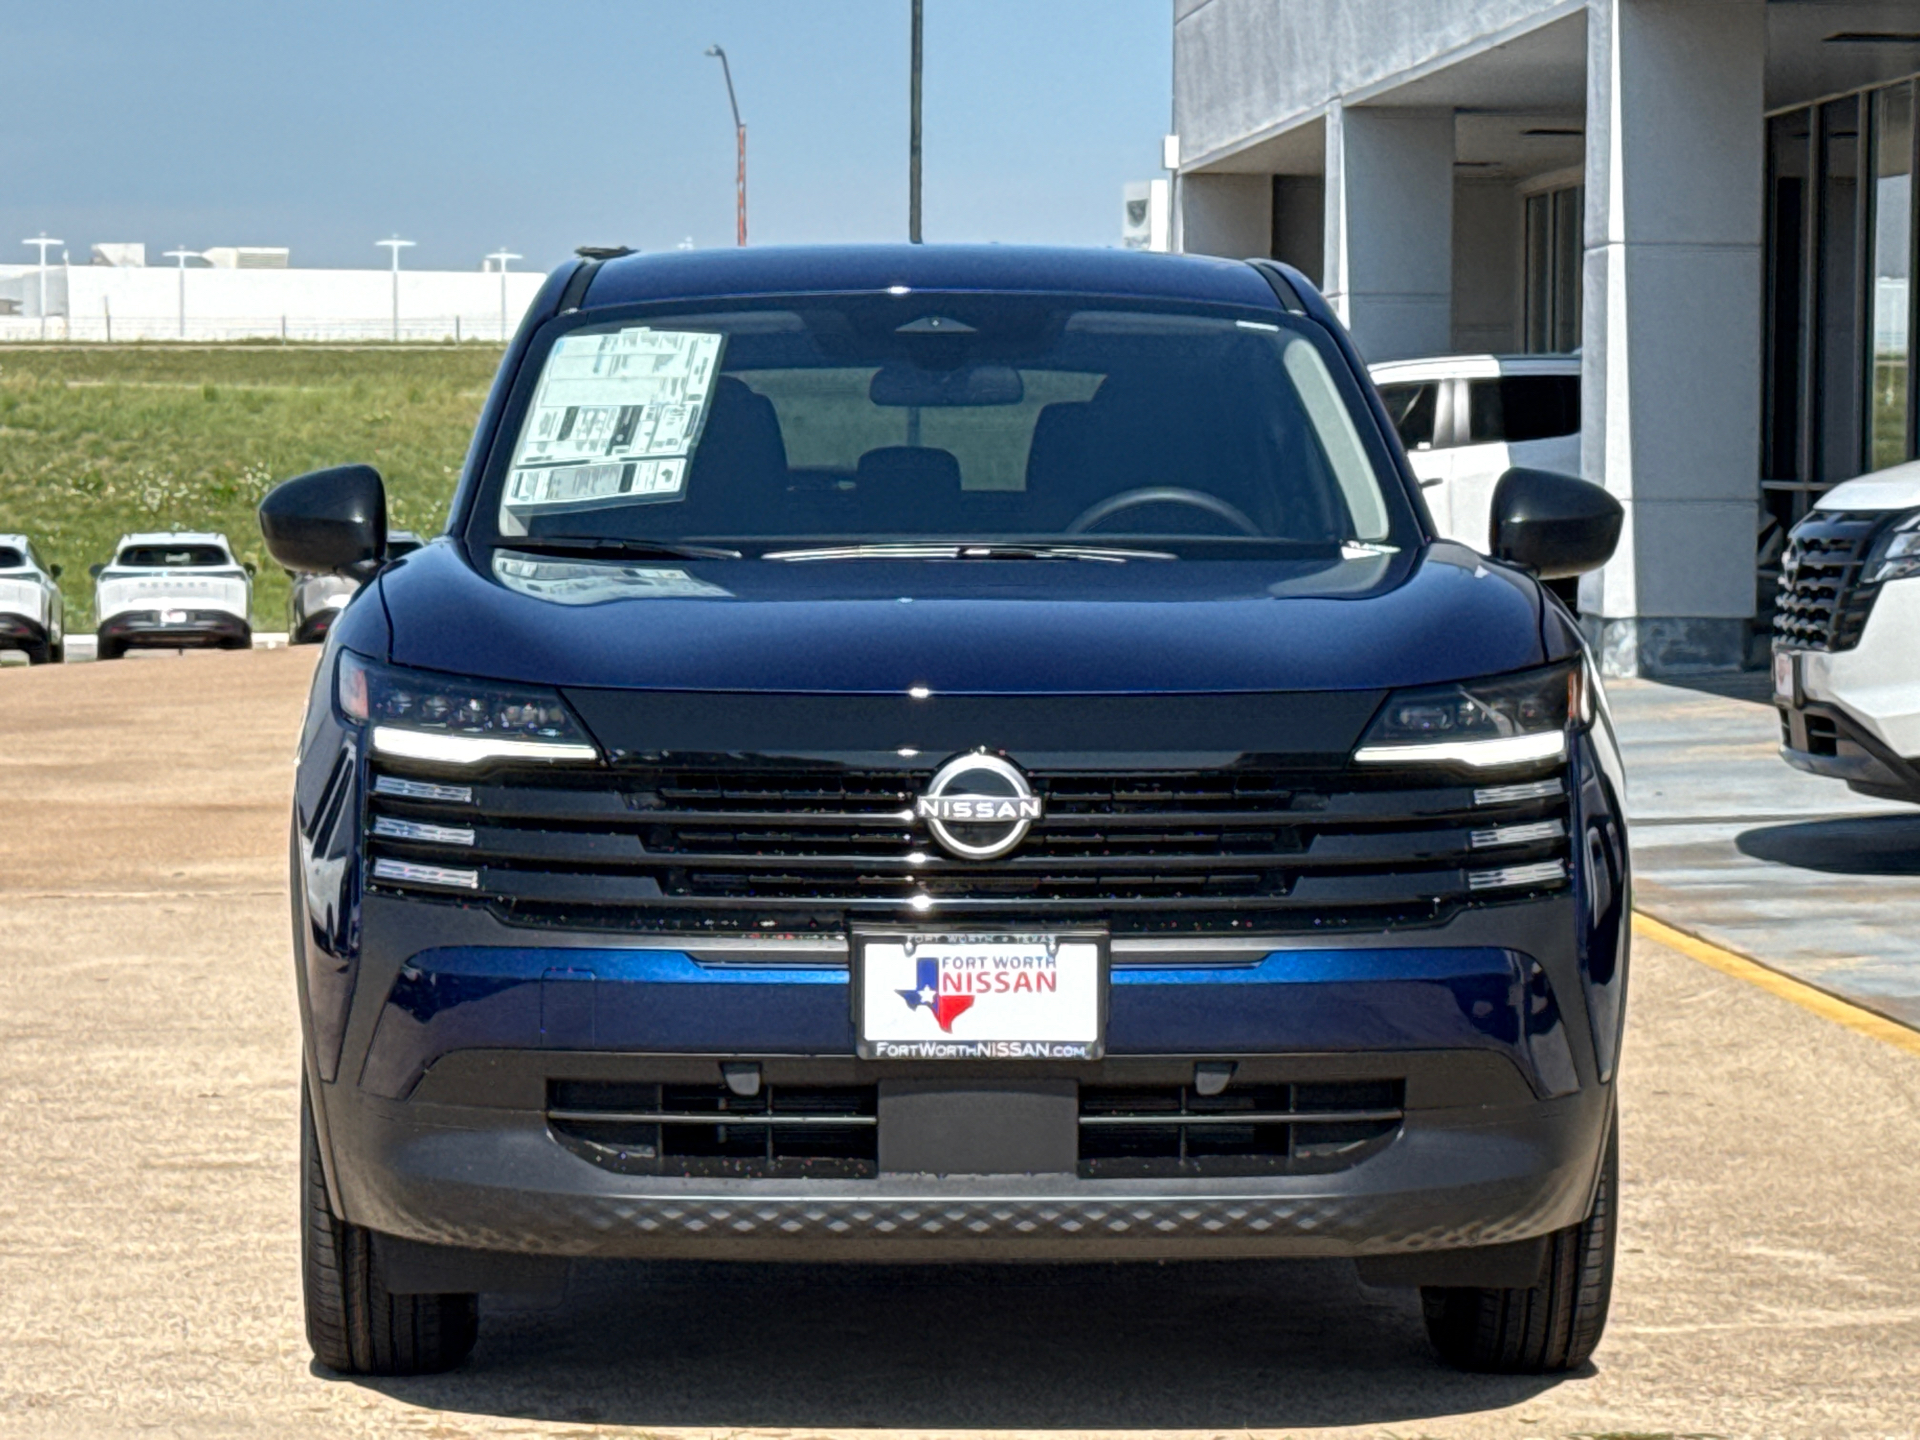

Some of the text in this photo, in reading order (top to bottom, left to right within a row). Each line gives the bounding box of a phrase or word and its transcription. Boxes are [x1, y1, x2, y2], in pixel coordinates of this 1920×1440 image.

[919, 799, 1039, 818] NISSAN
[942, 956, 1057, 970] FORT WORTH
[942, 971, 1057, 993] NISSAN
